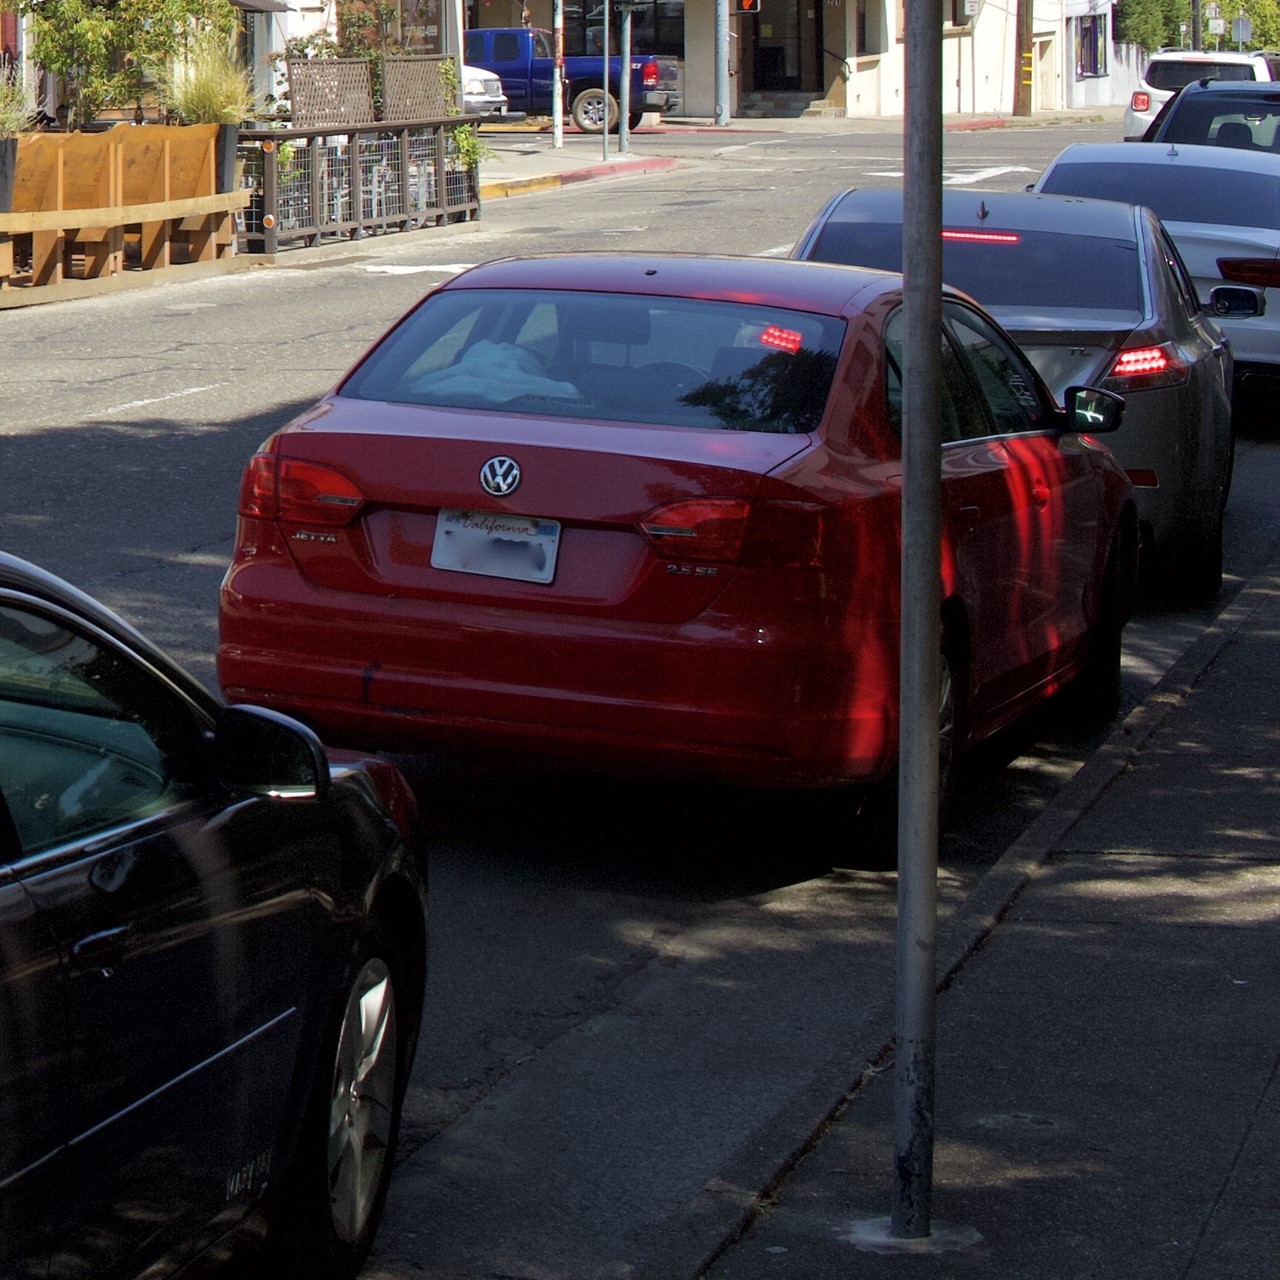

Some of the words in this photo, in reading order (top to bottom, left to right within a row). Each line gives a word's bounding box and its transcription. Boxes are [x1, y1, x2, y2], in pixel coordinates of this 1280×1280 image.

[462, 515, 538, 536] California
[291, 530, 336, 542] JETTA
[695, 566, 718, 577] SE
